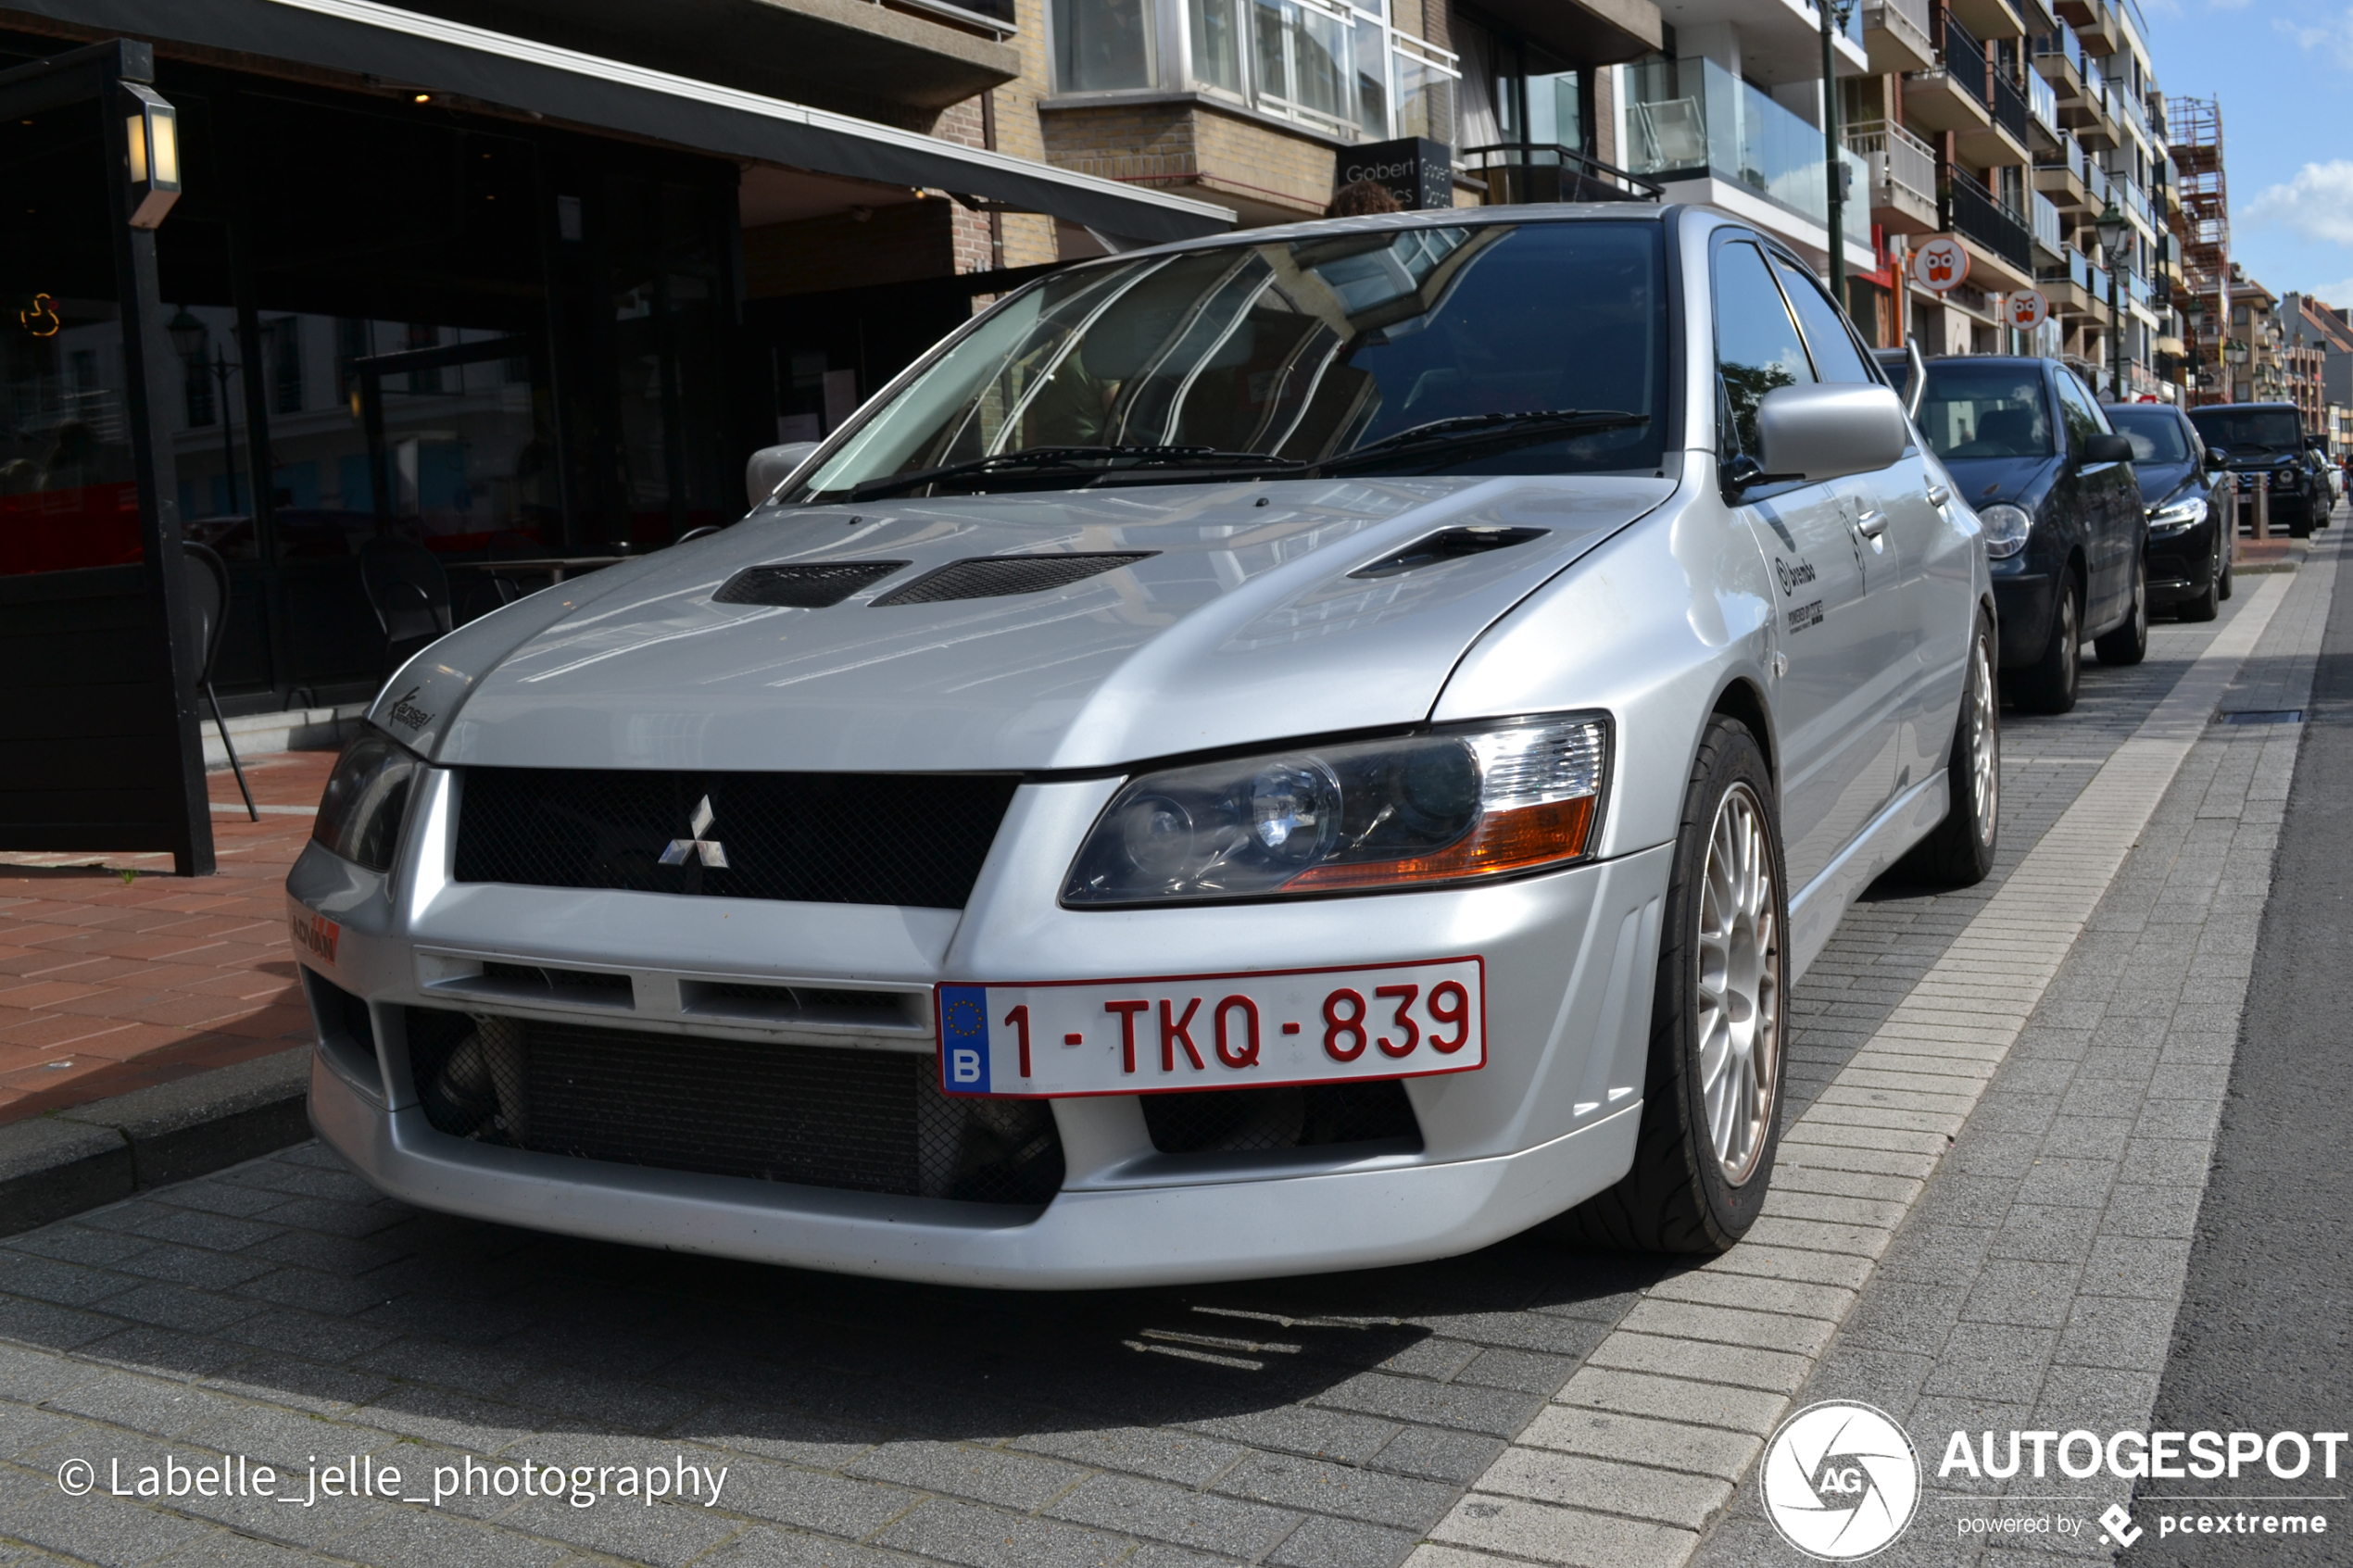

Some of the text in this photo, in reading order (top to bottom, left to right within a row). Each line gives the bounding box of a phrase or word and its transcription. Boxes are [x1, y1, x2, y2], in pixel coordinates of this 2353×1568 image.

[1346, 157, 1416, 183] Gobert
[389, 686, 435, 727] Kansai
[952, 1049, 981, 1084] B
